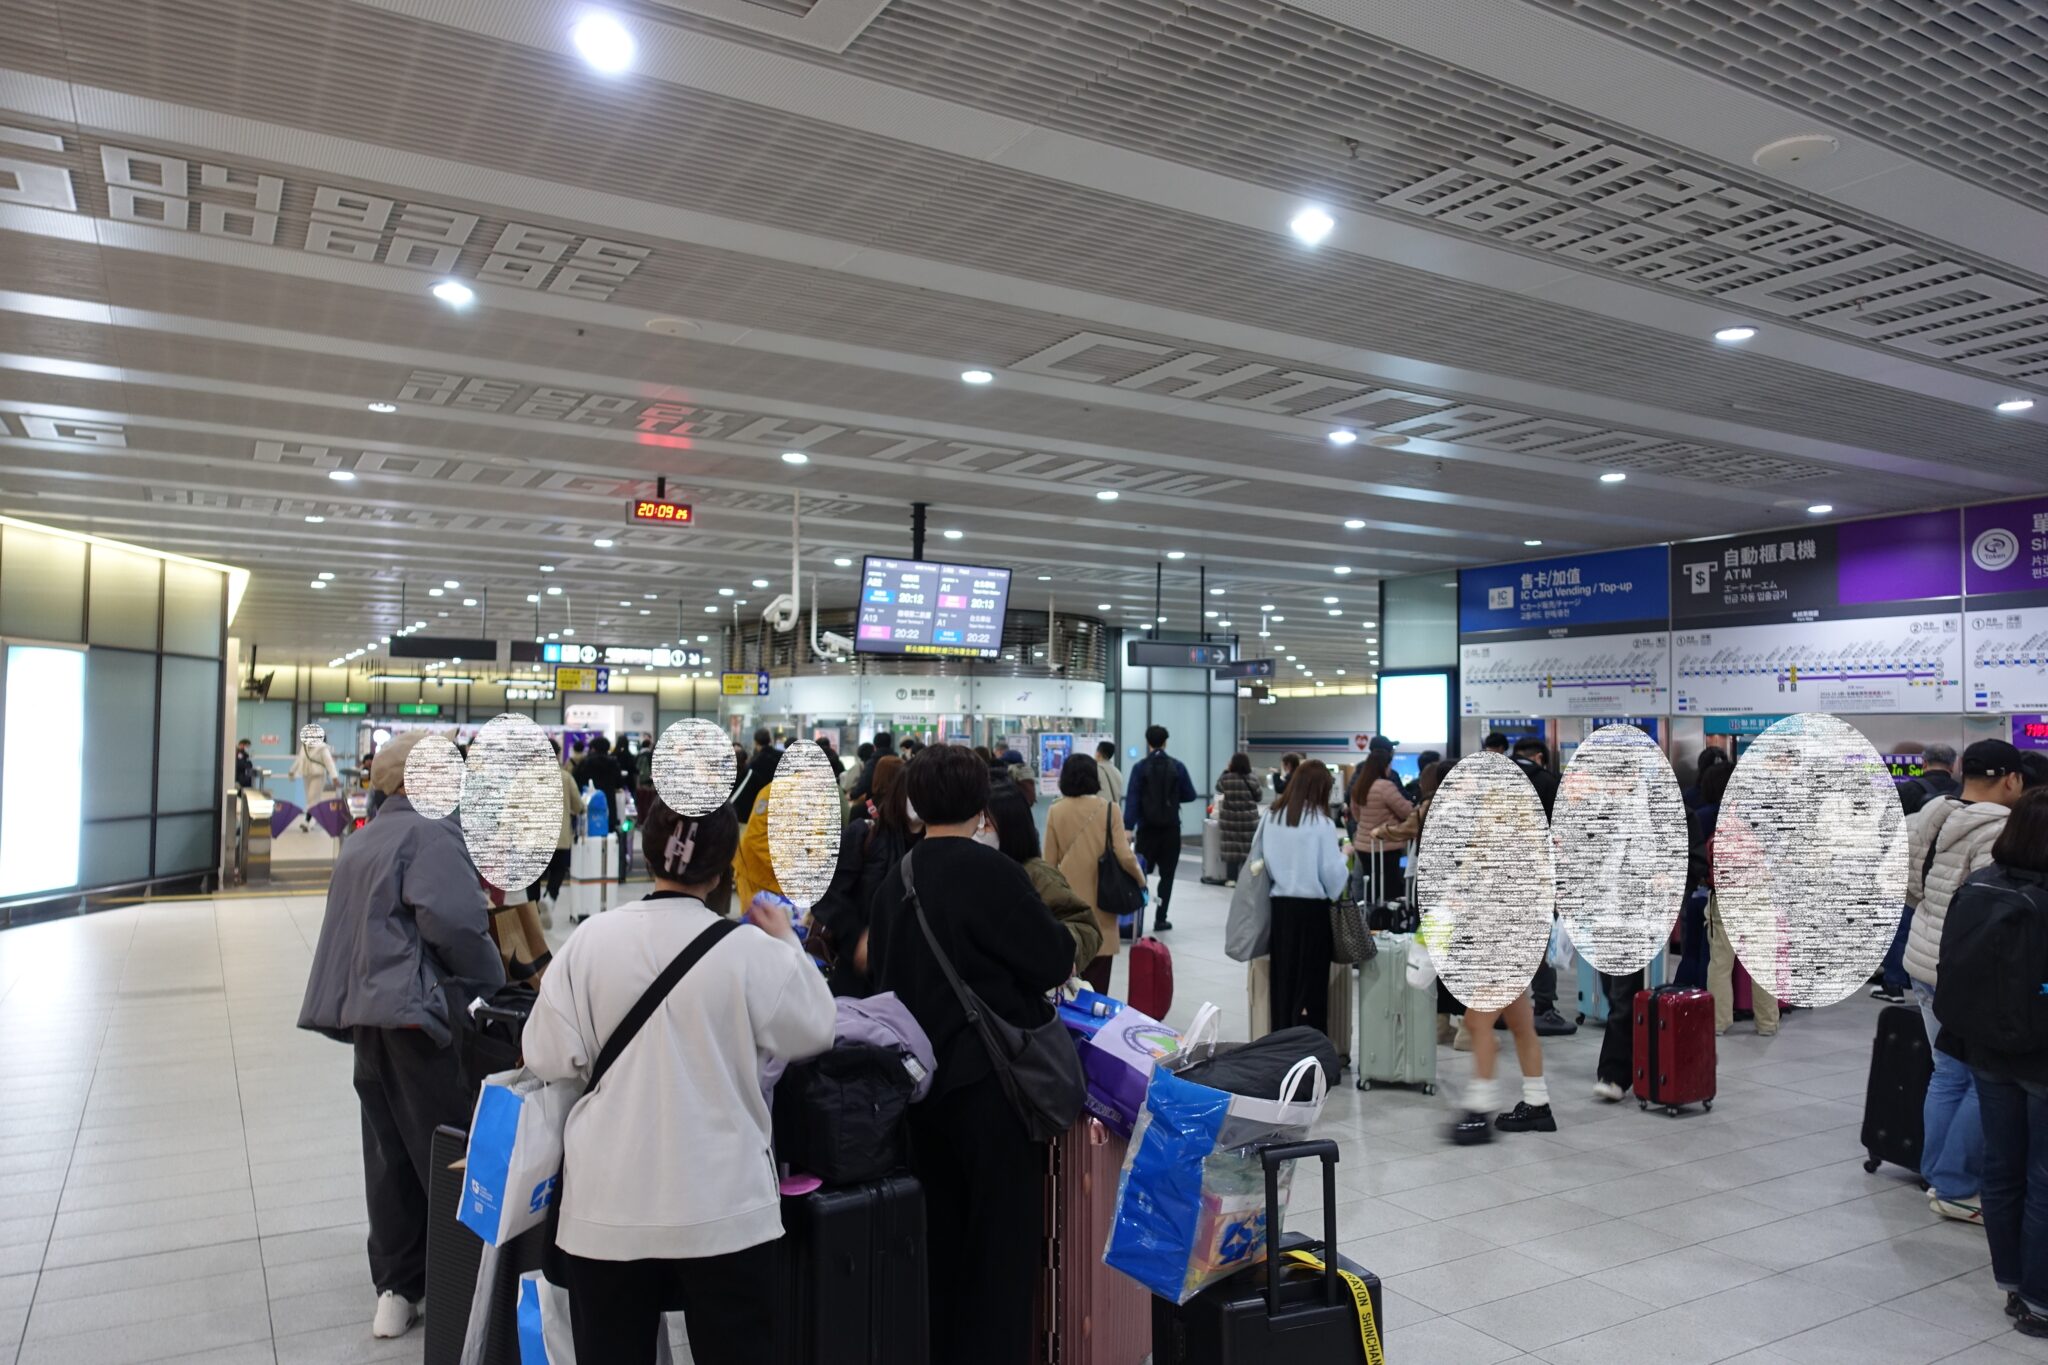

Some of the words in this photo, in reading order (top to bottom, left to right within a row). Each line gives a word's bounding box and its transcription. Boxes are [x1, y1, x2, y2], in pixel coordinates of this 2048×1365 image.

[638, 503, 674, 518] 20:09
[1724, 539, 1817, 568] 自動櫃員機
[1520, 568, 1581, 589] 售卡/加值
[1724, 568, 1752, 581] ATM
[1497, 590, 1508, 600] IC
[1520, 591, 1531, 600] IC
[1532, 588, 1553, 599] Card
[1555, 584, 1591, 598] Vending
[1599, 581, 1633, 594] Top-up
[1892, 764, 1904, 776] In
